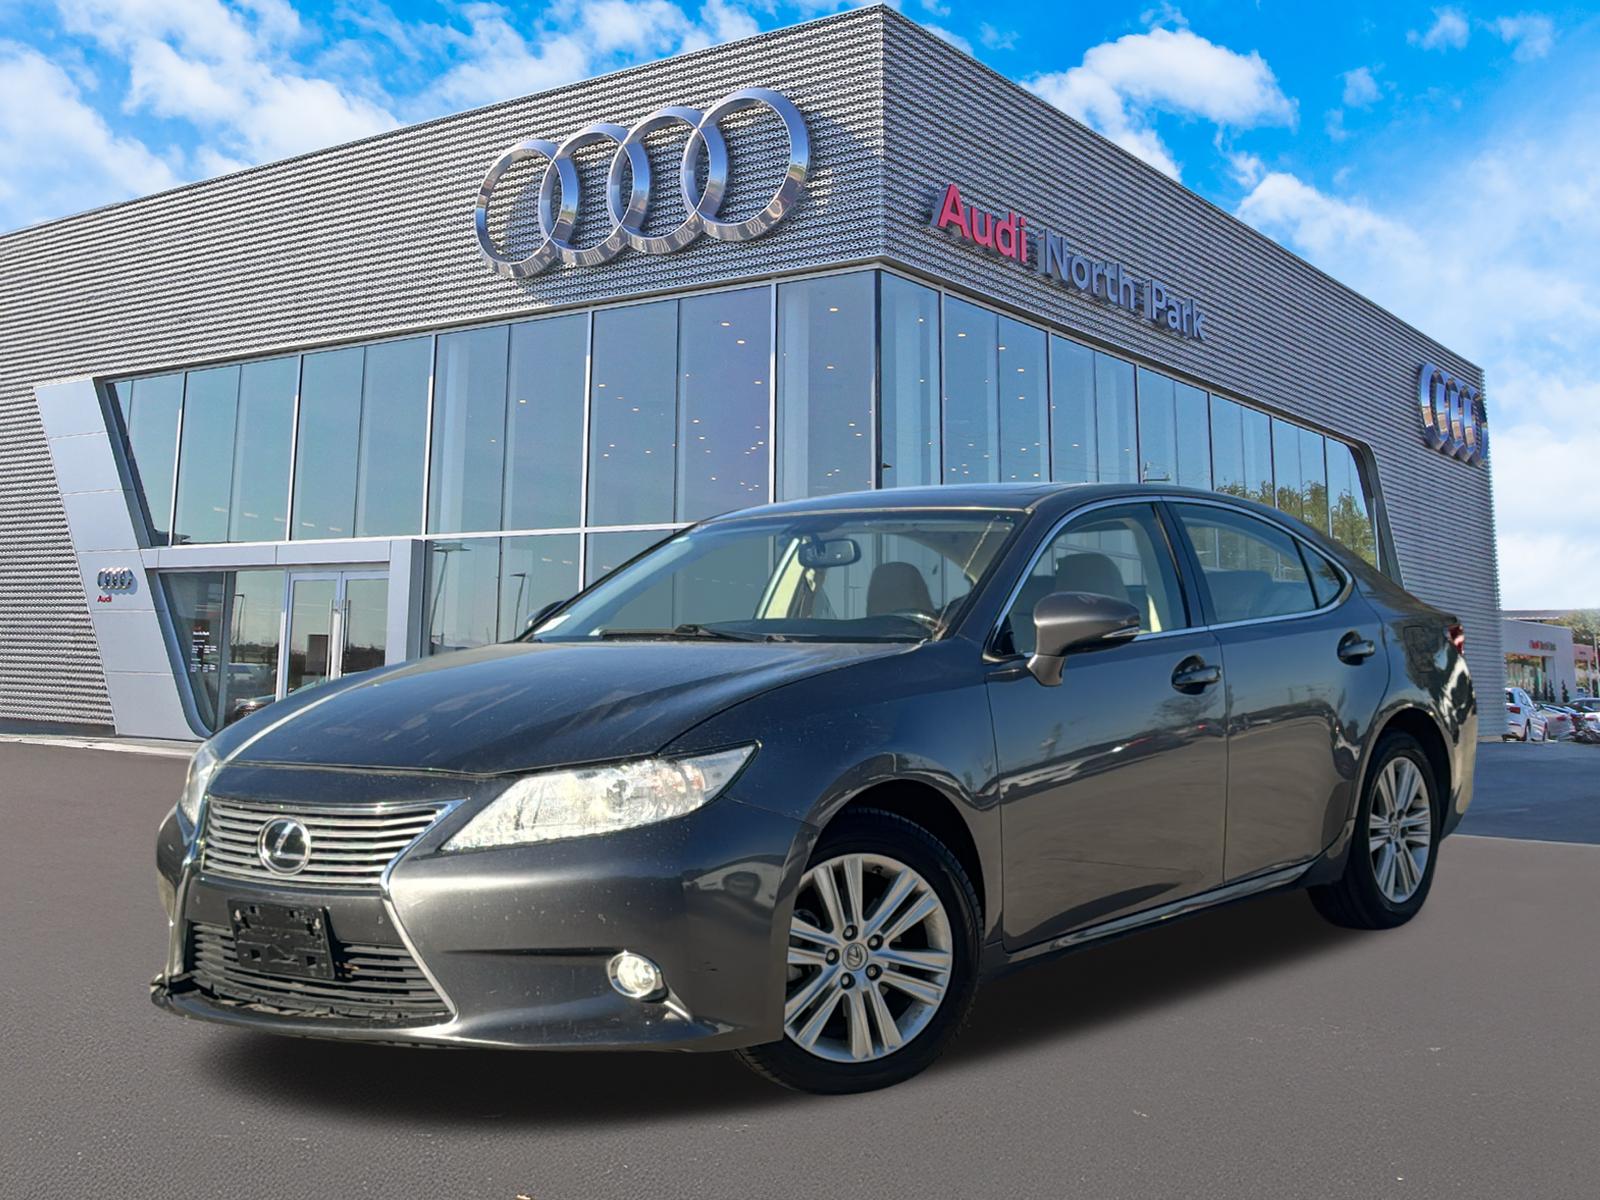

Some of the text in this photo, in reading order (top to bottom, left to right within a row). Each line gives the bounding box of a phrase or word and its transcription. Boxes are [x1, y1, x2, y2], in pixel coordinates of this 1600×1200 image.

[935, 183, 1206, 340] Audi North Park
